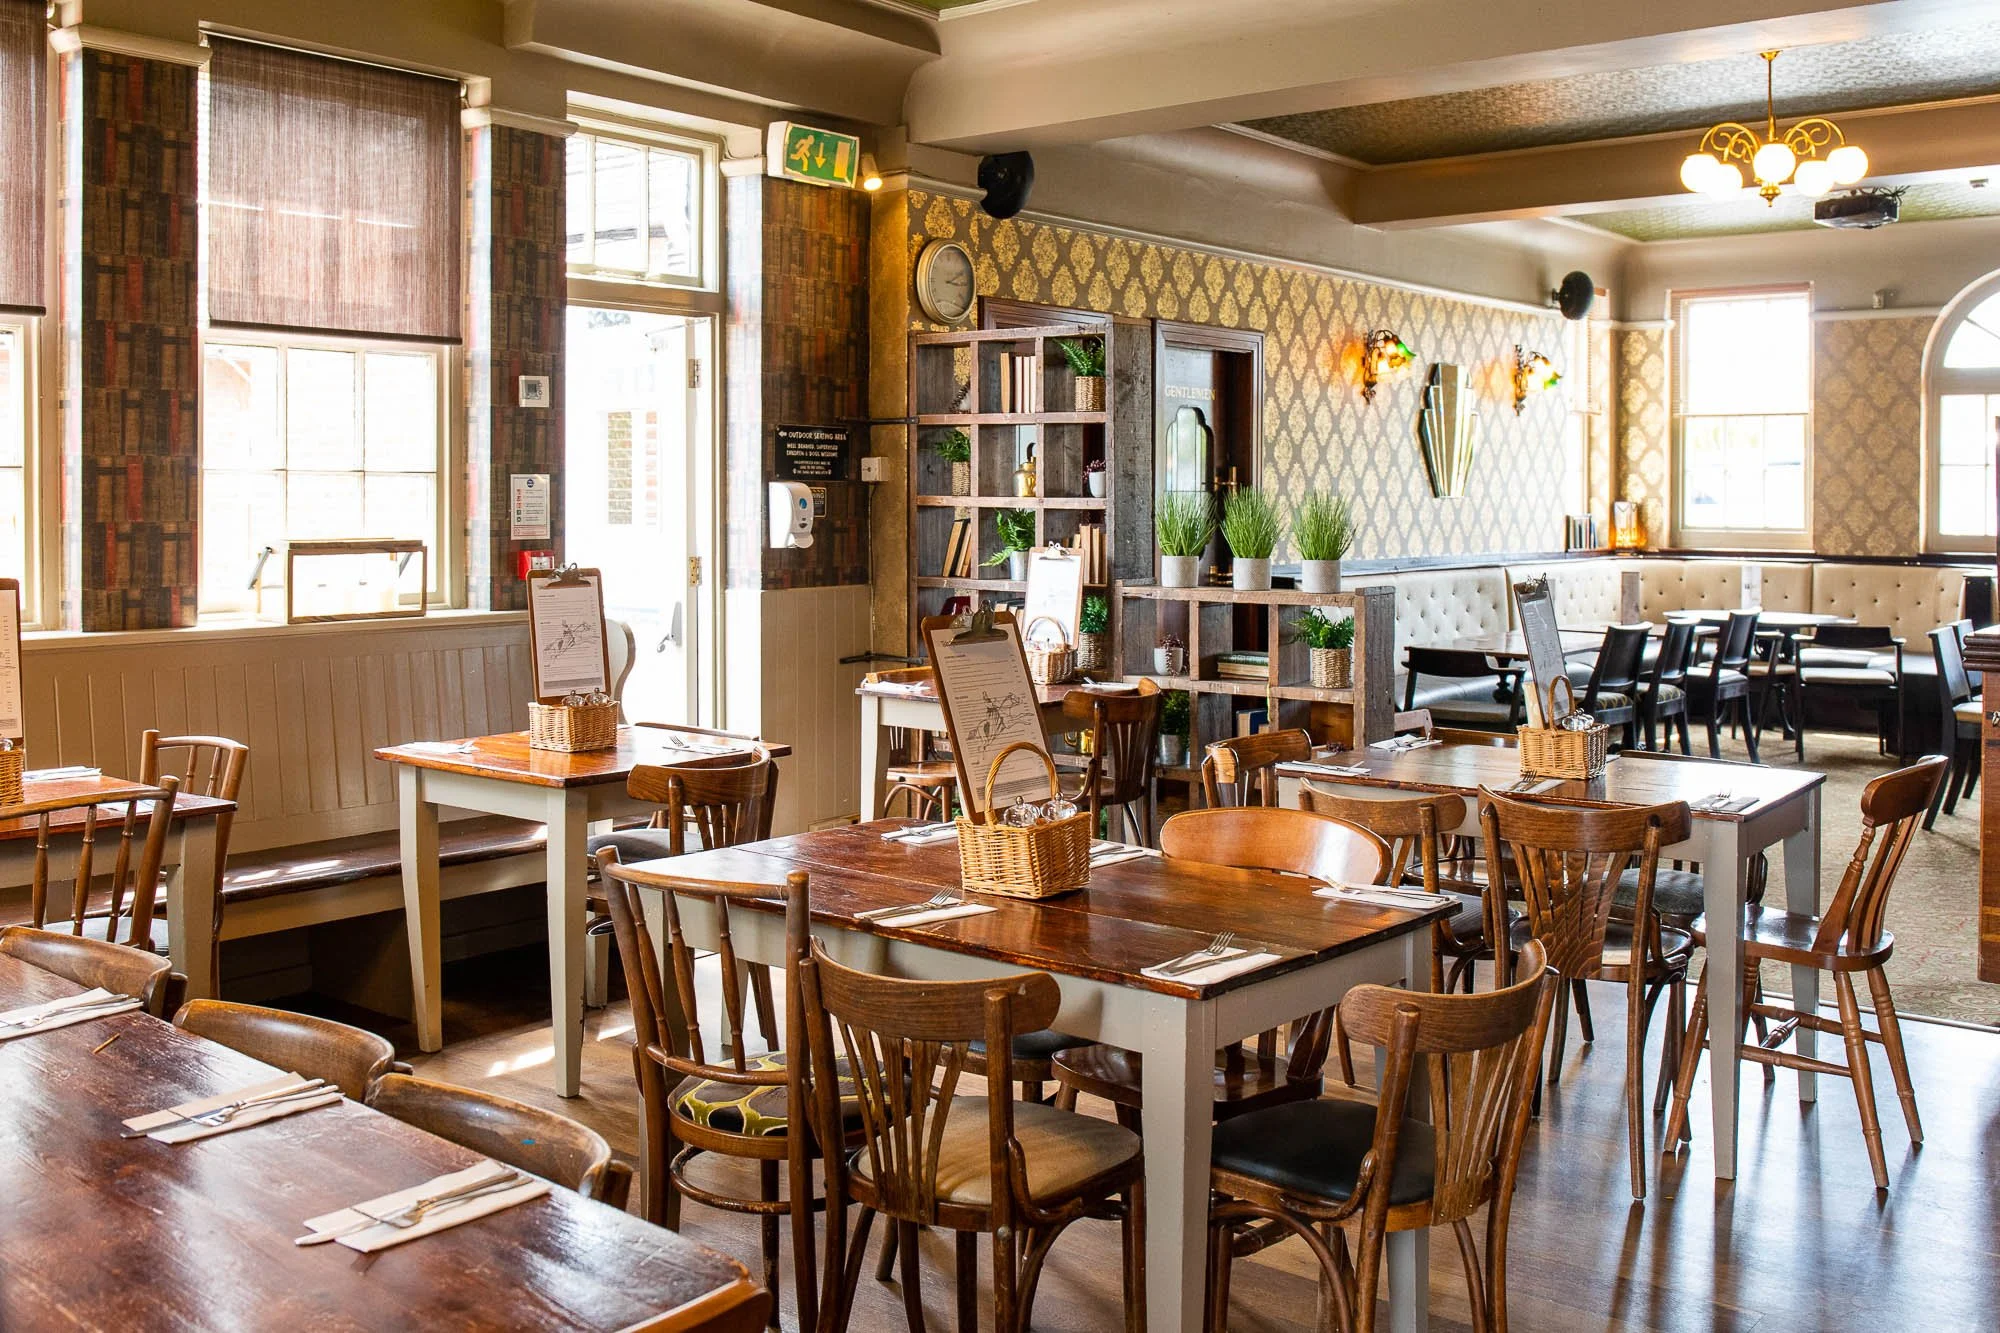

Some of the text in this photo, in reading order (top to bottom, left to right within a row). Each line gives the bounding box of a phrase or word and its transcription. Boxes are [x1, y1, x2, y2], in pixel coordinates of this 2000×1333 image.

[1165, 385, 1216, 400] GENTLEMEN
[788, 431, 847, 441] OUTDOOR SEATING AREA
